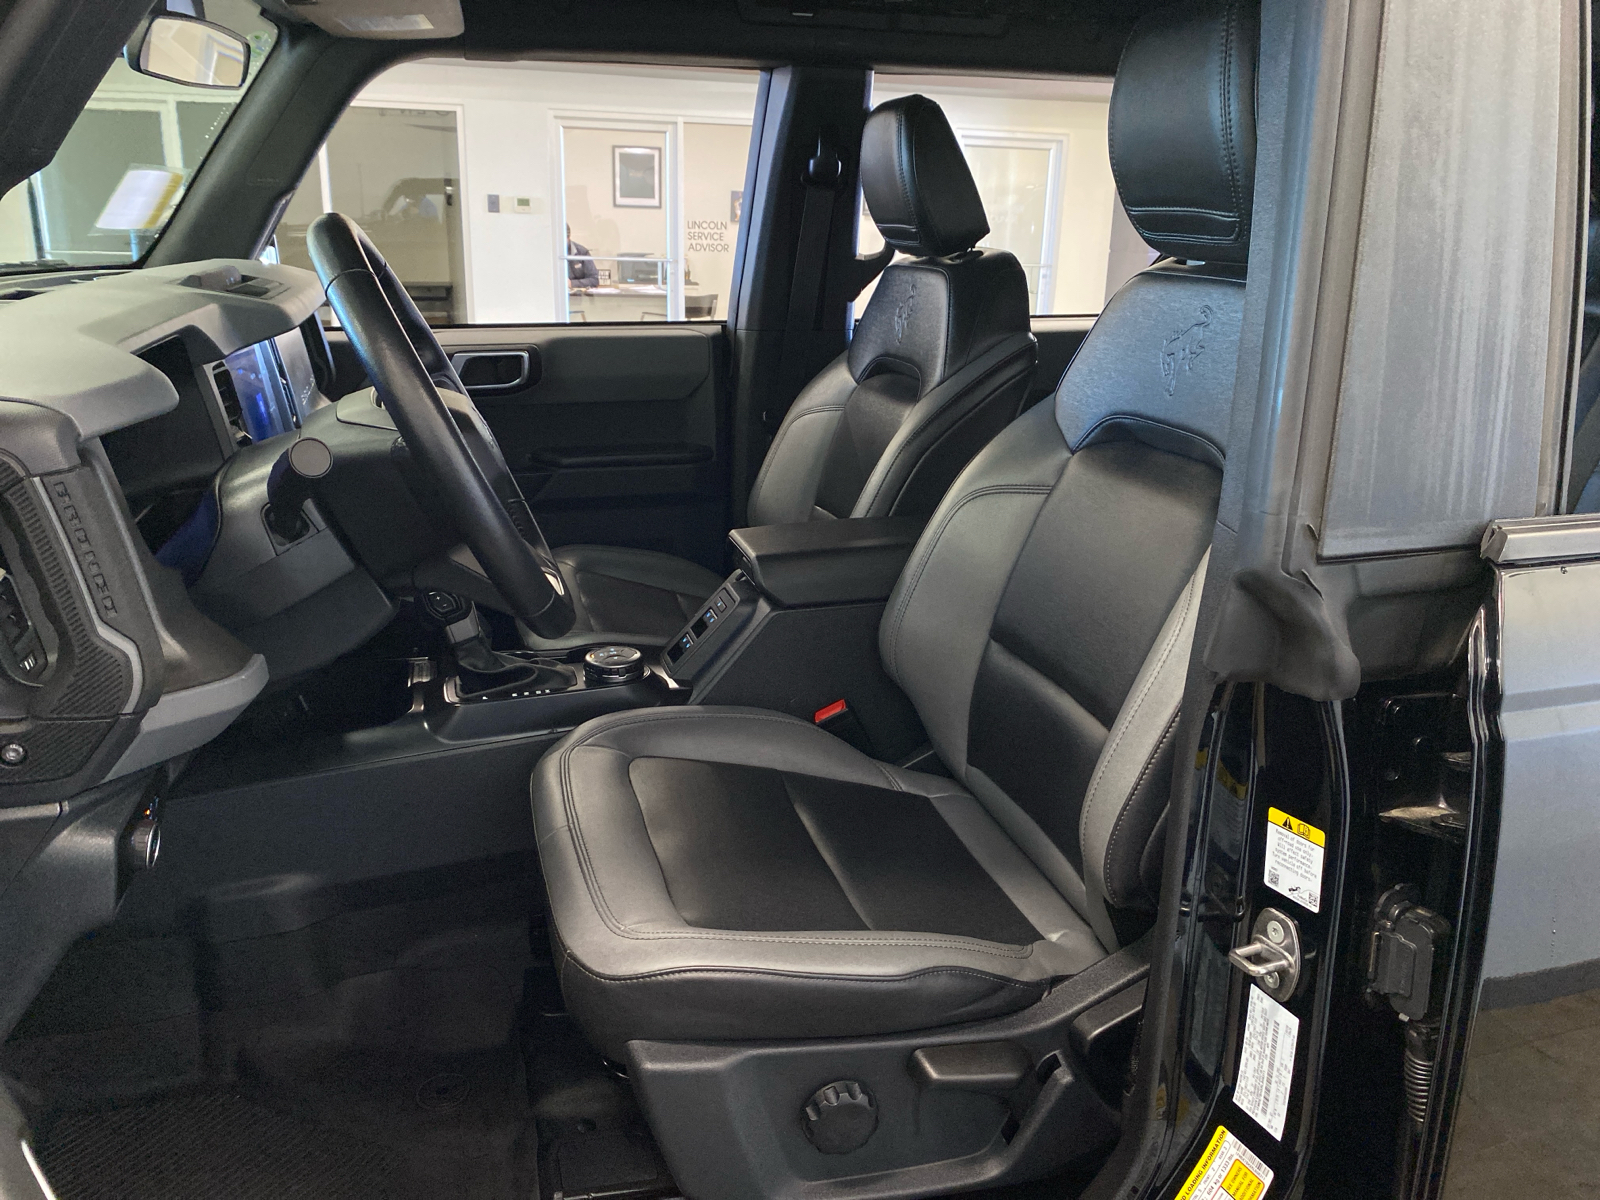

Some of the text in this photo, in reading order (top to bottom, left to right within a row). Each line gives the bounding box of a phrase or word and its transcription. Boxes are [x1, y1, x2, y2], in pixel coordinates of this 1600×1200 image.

[687, 220, 728, 230] LINCOLN
[688, 232, 724, 242] SERVICE
[688, 242, 730, 252] ADVISOR
[53, 480, 118, 618] BRONCO
[1186, 1130, 1226, 1194] LOADING INFORMATION
[1206, 1186, 1214, 1195] 604
[1221, 1161, 1230, 1172] 1333
[1232, 1180, 1244, 1197] MANUAL
